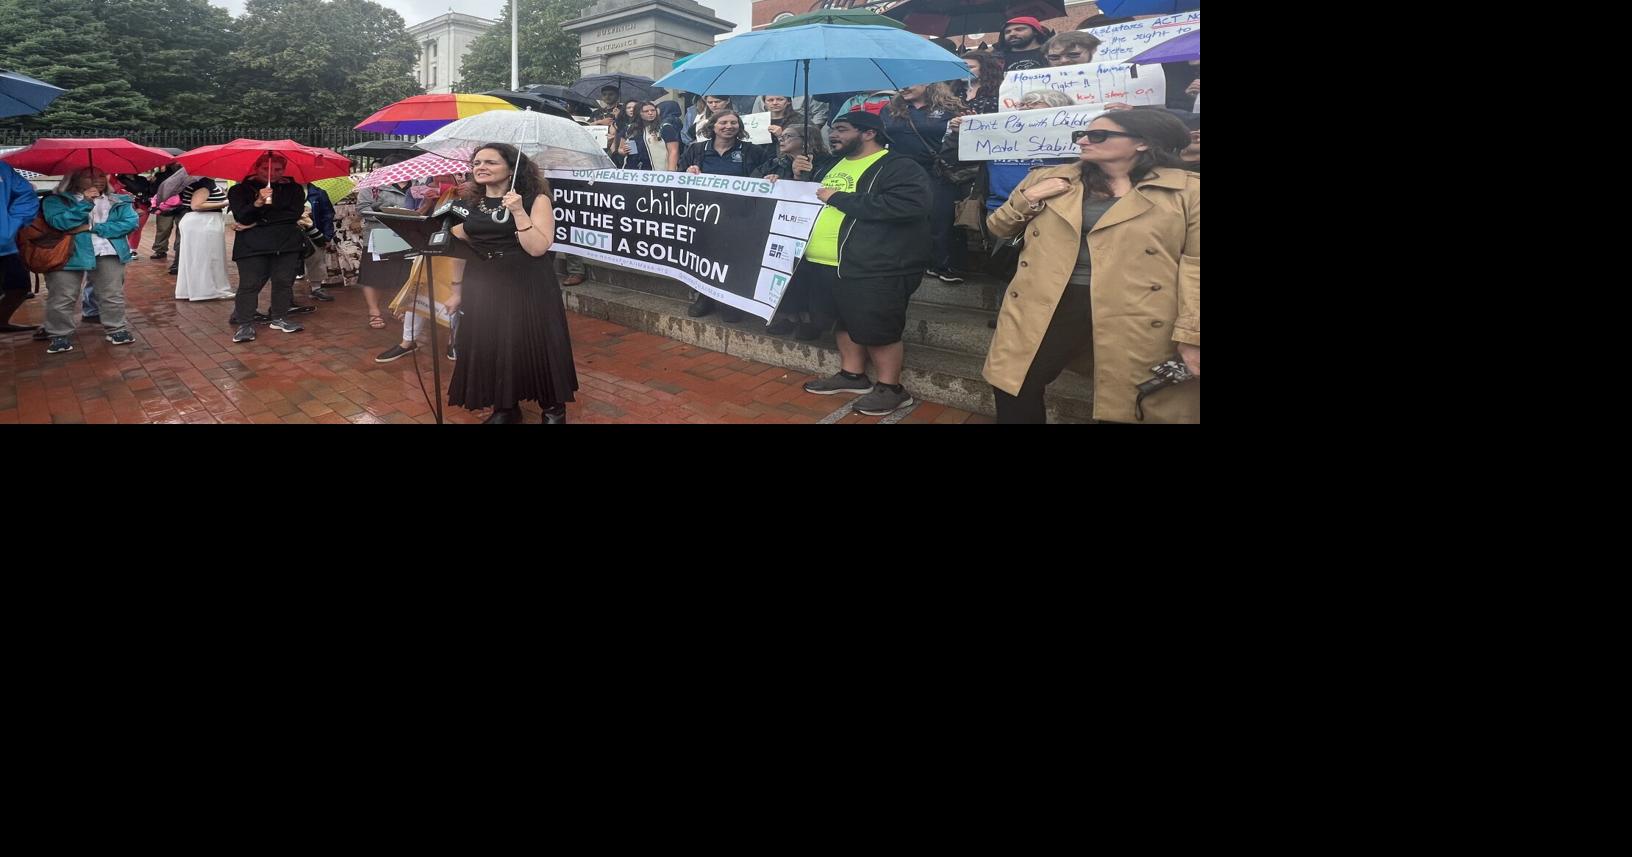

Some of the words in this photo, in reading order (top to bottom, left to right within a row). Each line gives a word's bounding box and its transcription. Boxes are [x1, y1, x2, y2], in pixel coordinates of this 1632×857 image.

[1152, 14, 1183, 26] ACT
[1013, 71, 1052, 84] Housing
[1004, 115, 1025, 133] Play
[596, 170, 639, 182] HEALEY:
[641, 173, 675, 184] STOP
[677, 175, 730, 189] SHELTER
[731, 179, 776, 194] CUTS!
[553, 188, 626, 210] PUTTING
[636, 189, 721, 225] children
[553, 207, 576, 223] ON
[579, 210, 614, 230] THE
[619, 216, 697, 244] STREET
[555, 226, 568, 241] S
[574, 229, 609, 249] NOT
[617, 237, 631, 254] A
[635, 240, 729, 284] SOLUTION
